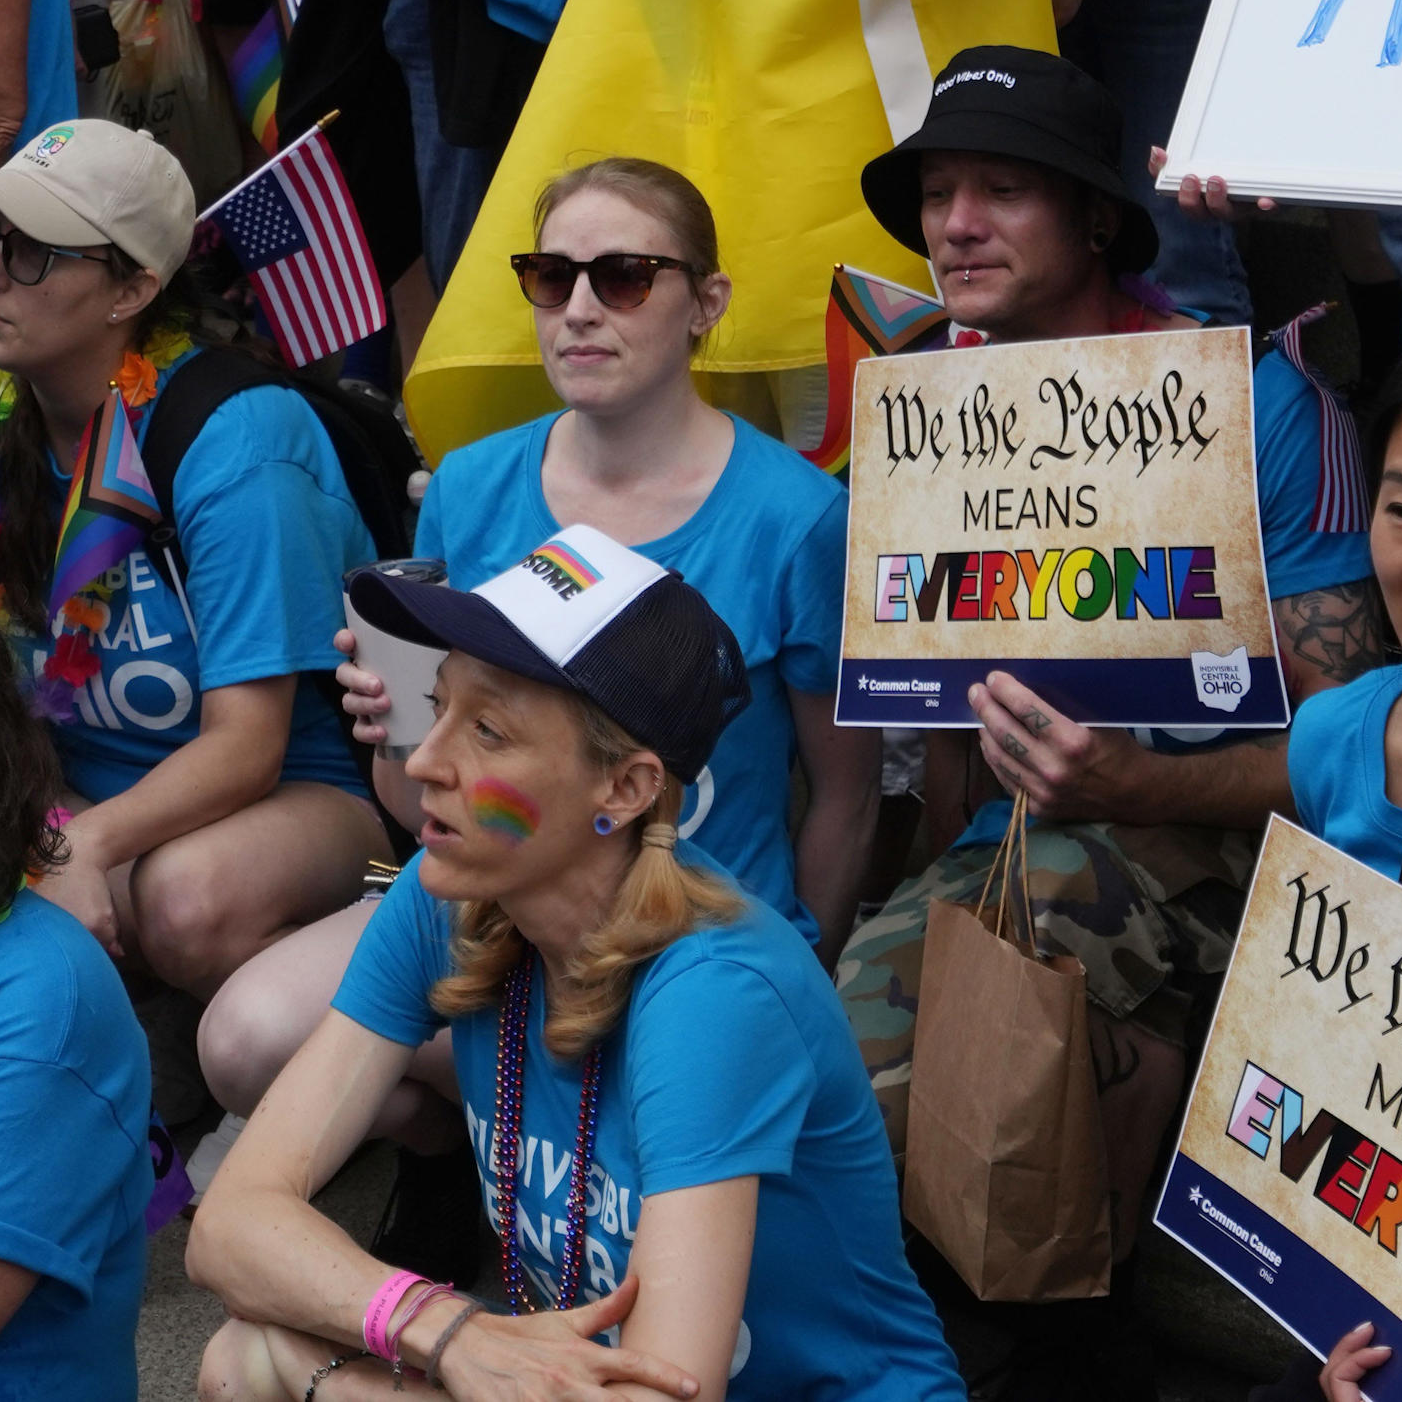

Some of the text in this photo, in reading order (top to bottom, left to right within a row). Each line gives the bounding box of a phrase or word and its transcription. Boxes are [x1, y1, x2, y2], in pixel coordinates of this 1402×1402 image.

[934, 69, 1016, 97] Good Vibes Only
[877, 369, 1220, 478] We the People
[963, 485, 1098, 532] MEANS
[874, 547, 1224, 624] EVERYONE
[869, 679, 942, 692] Common Cause
[1201, 672, 1241, 682] CENTRAL
[1203, 681, 1243, 695] OHIO
[1281, 872, 1373, 1013] We
[1200, 1198, 1284, 1269] Common Cause
[1258, 1266, 1275, 1286] Ohio
